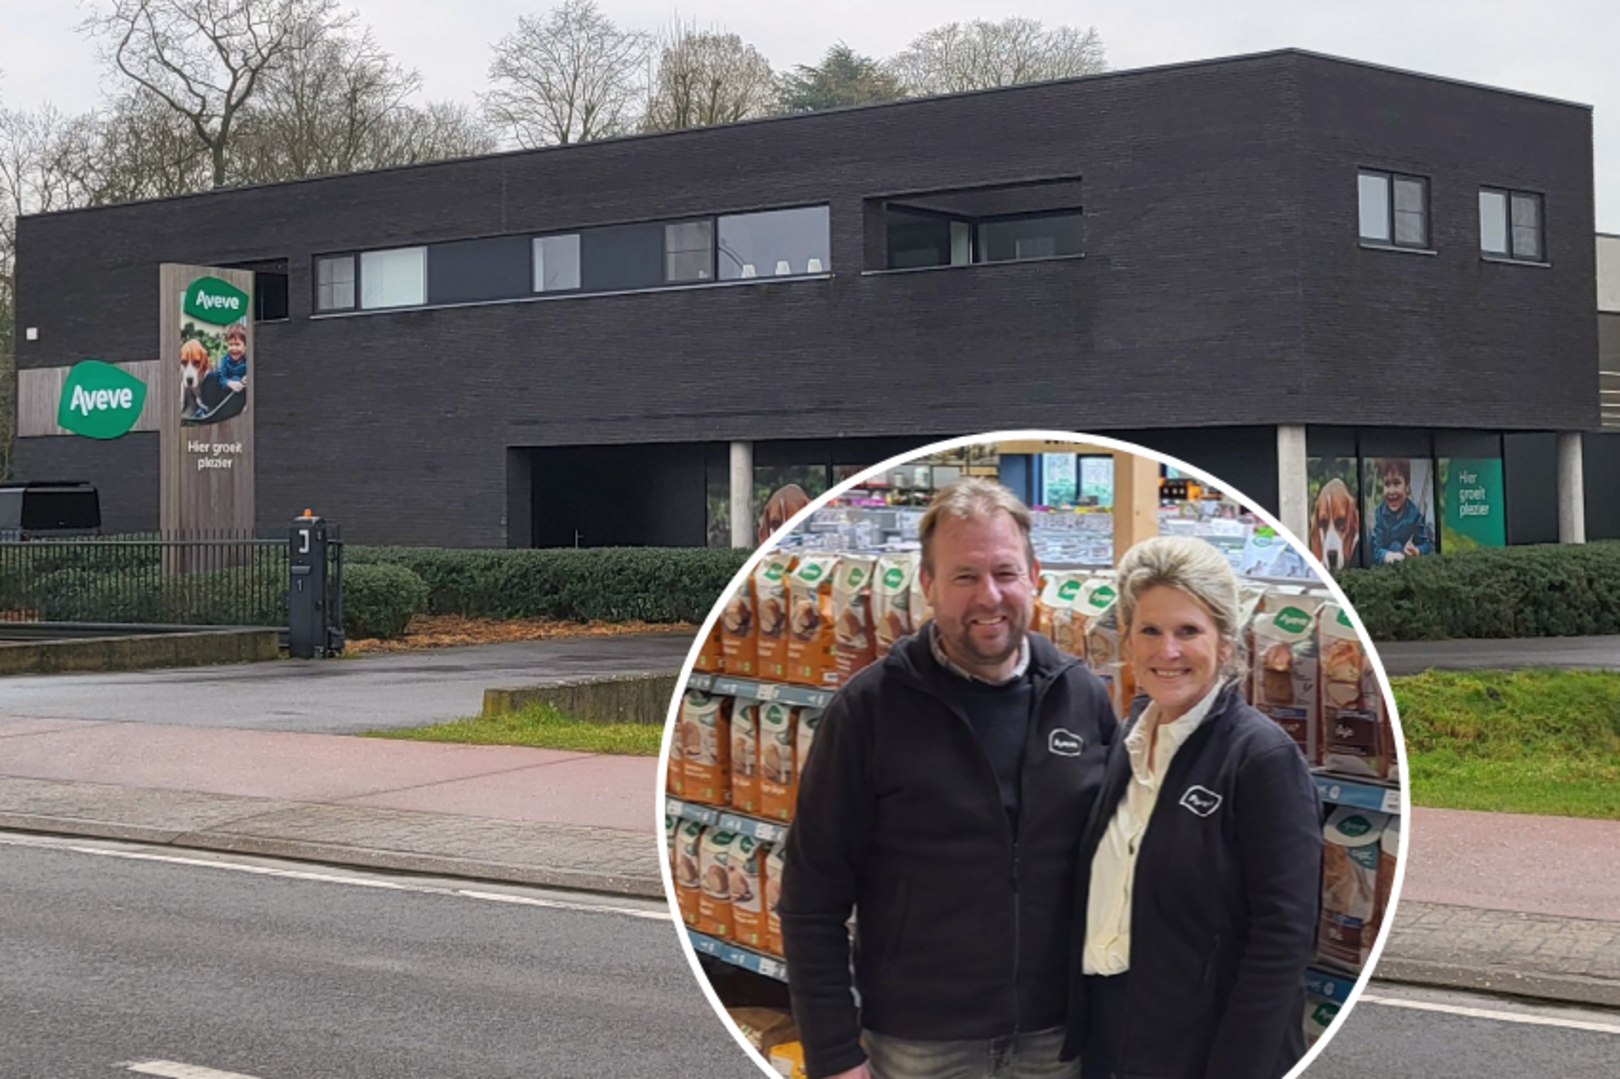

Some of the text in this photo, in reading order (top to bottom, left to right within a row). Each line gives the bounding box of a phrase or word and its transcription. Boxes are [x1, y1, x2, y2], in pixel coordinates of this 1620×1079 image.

[196, 290, 239, 310] Aveve
[70, 385, 132, 416] Aveve
[188, 440, 243, 456] Hier groeit
[198, 457, 233, 471] plezier
[1459, 502, 1489, 519] plezier
